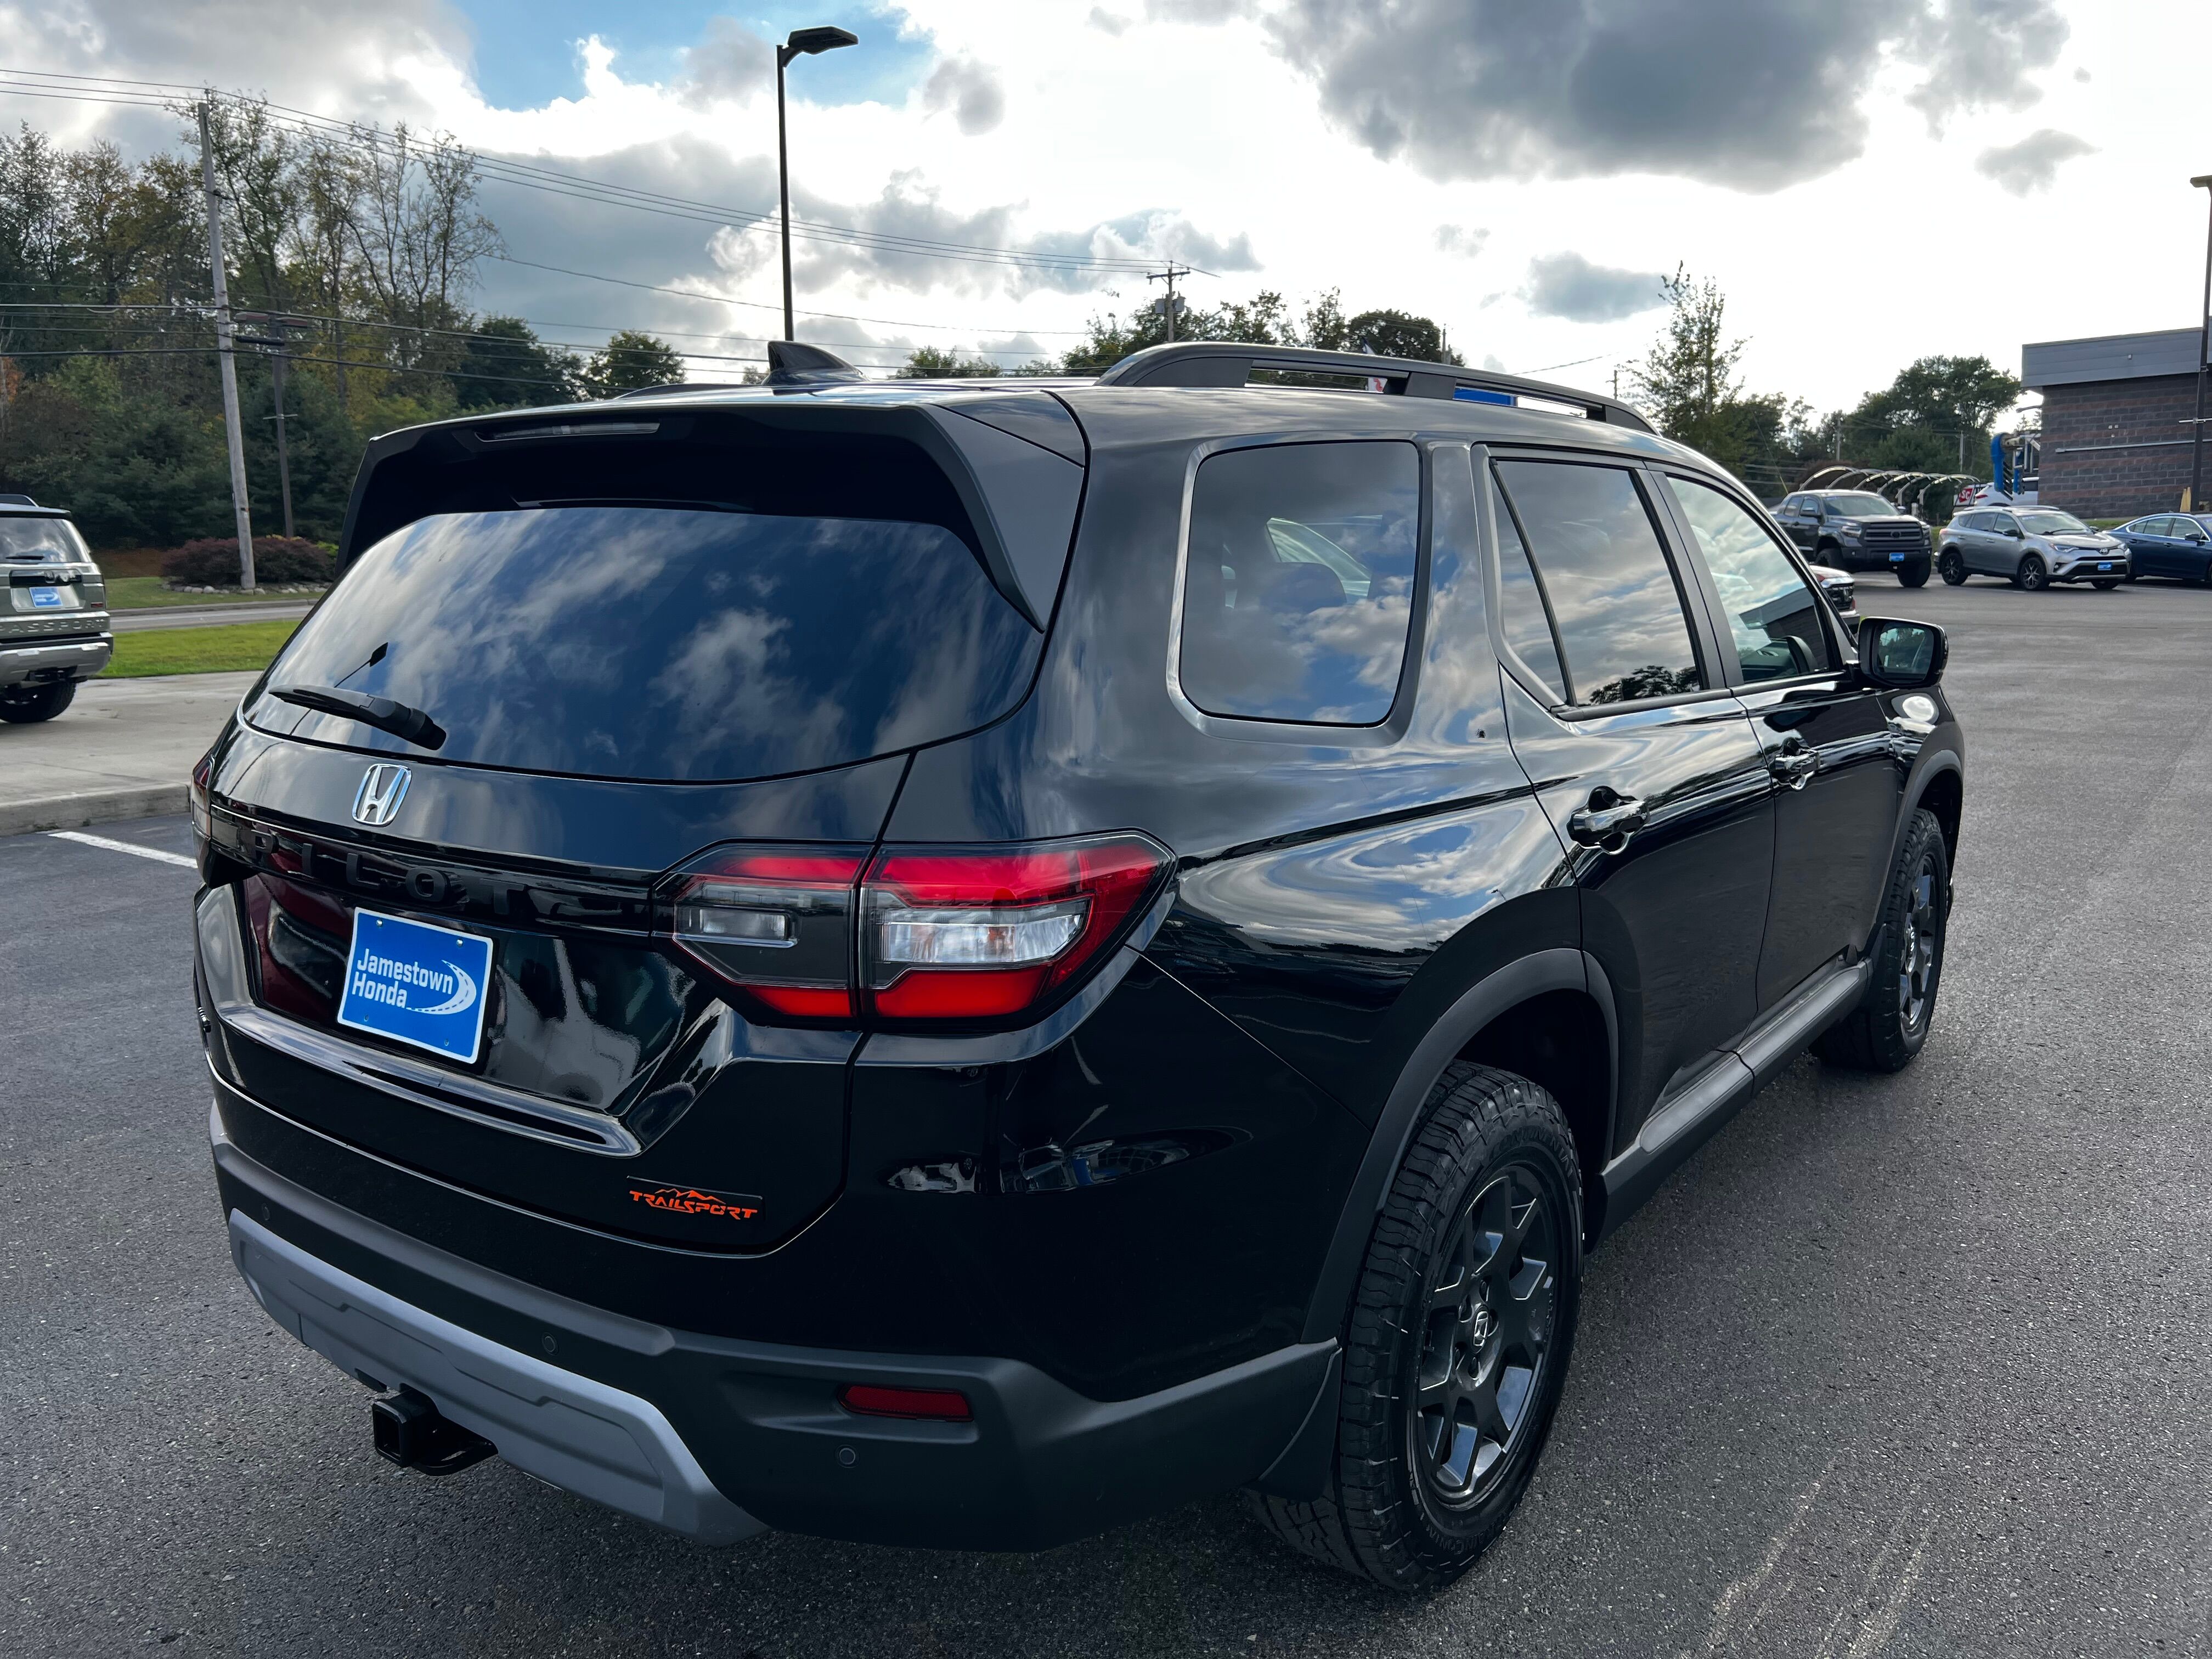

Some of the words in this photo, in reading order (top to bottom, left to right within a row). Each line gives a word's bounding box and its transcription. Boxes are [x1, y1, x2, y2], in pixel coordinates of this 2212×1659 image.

[1959, 489, 1971, 500] SC
[250, 829, 526, 915] PILOT
[352, 971, 408, 1008] Honda
[357, 948, 453, 995] Jamestown
[629, 1190, 758, 1220] TRAILSPORT
